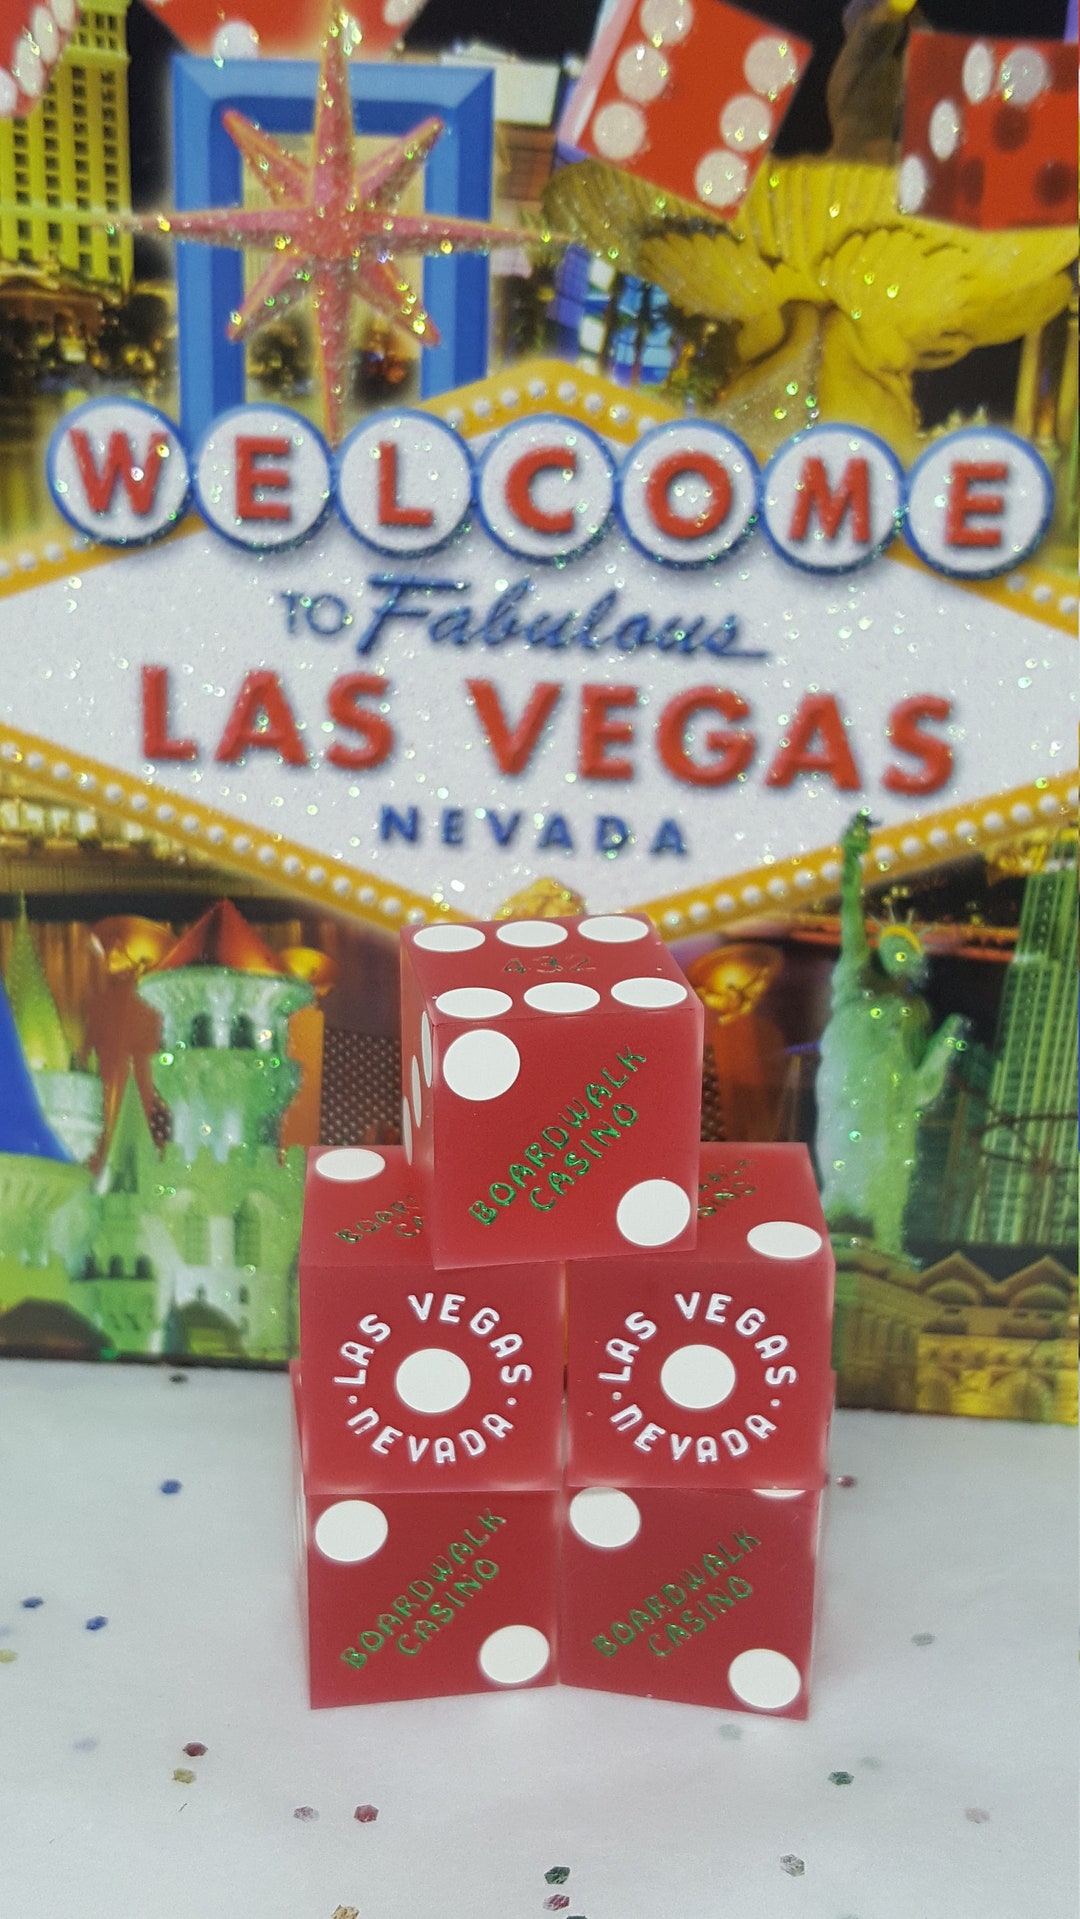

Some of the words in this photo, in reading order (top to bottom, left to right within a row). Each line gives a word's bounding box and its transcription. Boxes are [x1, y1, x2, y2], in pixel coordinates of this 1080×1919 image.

[69, 428, 1009, 546] WELCOME
[281, 590, 348, 636] TO
[356, 573, 770, 656] Fabulous
[139, 665, 396, 770] LAS
[466, 677, 956, 797] VEGAS
[378, 804, 689, 859] NEVADA
[469, 1045, 646, 1226] BOARDWALK
[530, 1103, 638, 1212] CASINO
[334, 1314, 391, 1386] LAS
[408, 1293, 532, 1384] VEGAS
[598, 1311, 657, 1382] LAS
[675, 1291, 797, 1386] VEGAS
[347, 1405, 514, 1464] NEVADA
[610, 1403, 777, 1463] NEVADA
[340, 1508, 506, 1669] BOARDWALK
[396, 1559, 499, 1656] CASINO
[593, 1528, 761, 1657] BOARDWALK
[646, 1576, 752, 1657] CASINO
